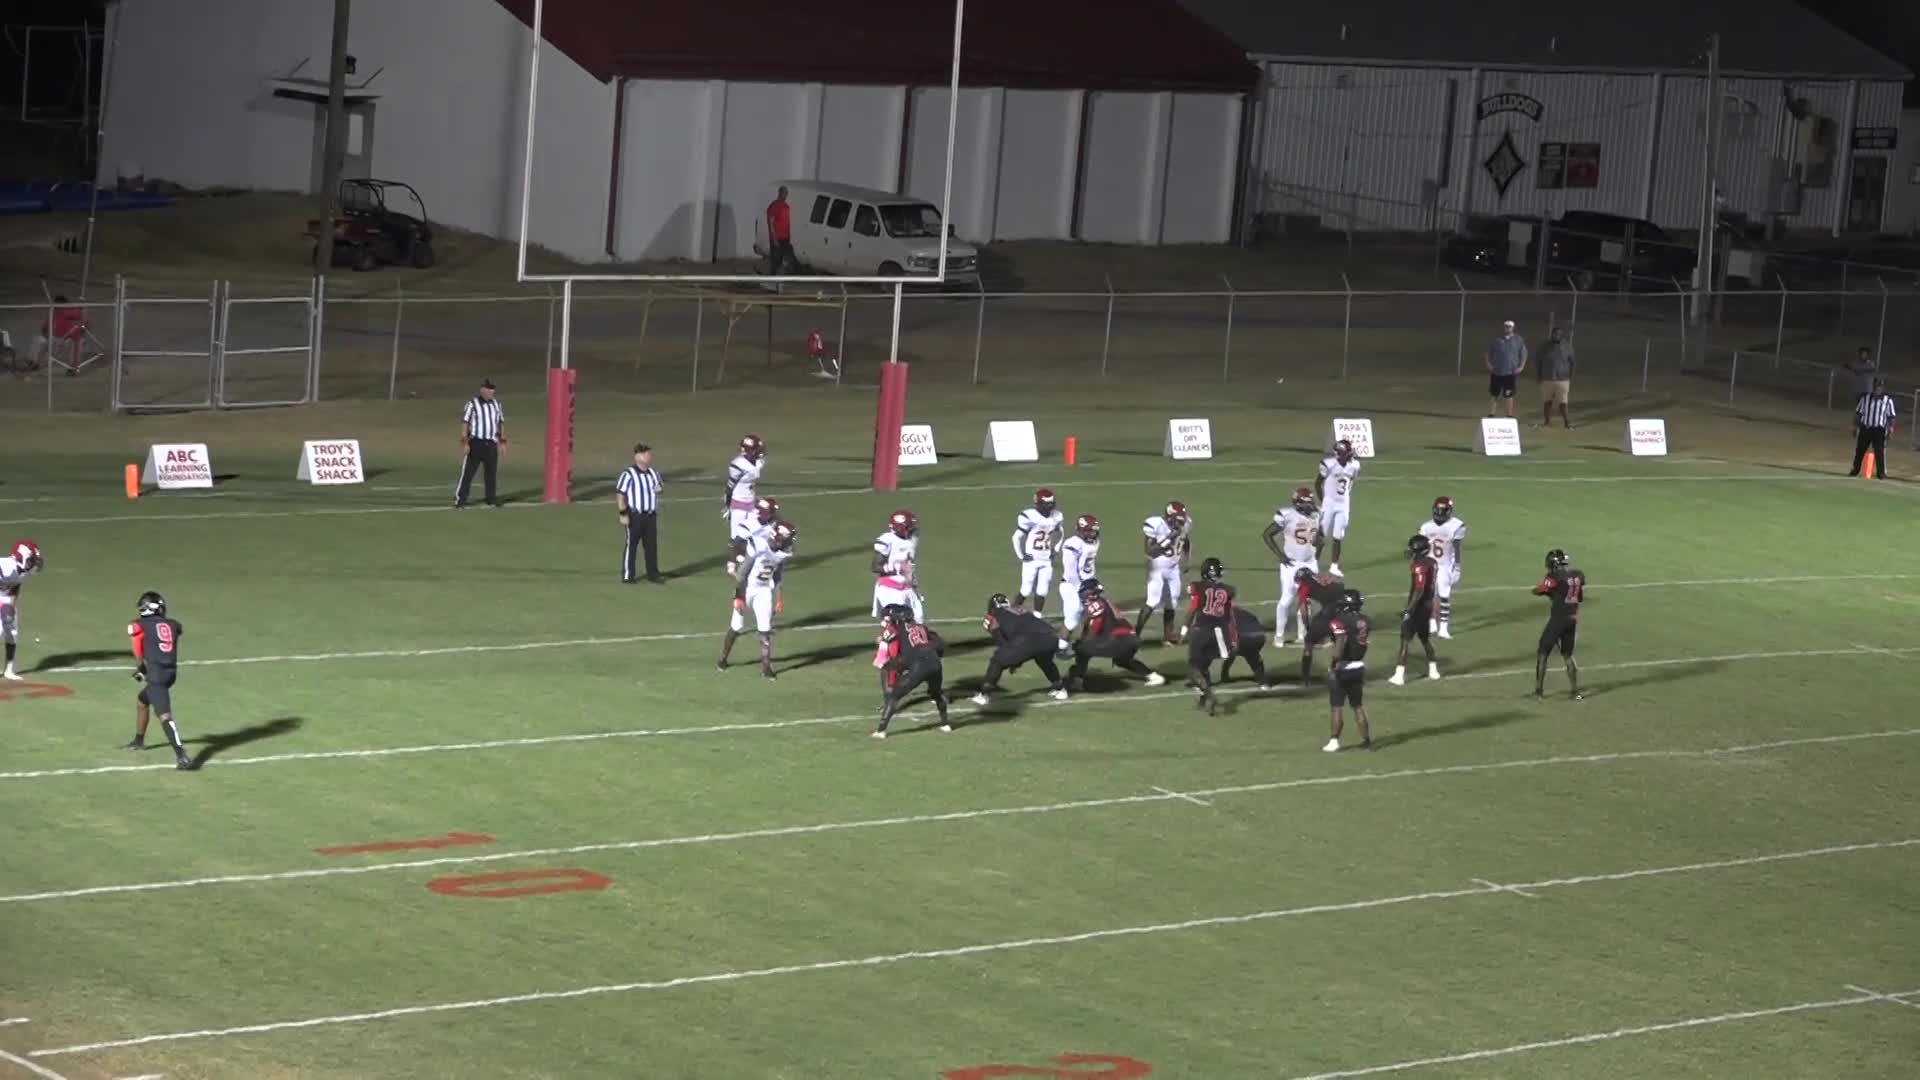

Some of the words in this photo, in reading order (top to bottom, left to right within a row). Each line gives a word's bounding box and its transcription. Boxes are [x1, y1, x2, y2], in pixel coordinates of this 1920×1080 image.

[901, 433, 928, 443] GGLY
[312, 443, 355, 455] TROY'S
[899, 445, 932, 455] IGGLY
[1174, 443, 1210, 452] CLEANERS
[166, 449, 200, 463] ABC
[314, 456, 357, 468] SNACK
[158, 463, 208, 473] LEARNING
[316, 468, 359, 480] SHACK
[158, 472, 211, 481] FOUNDATION
[1202, 587, 1228, 616] 12
[156, 622, 173, 653] 9
